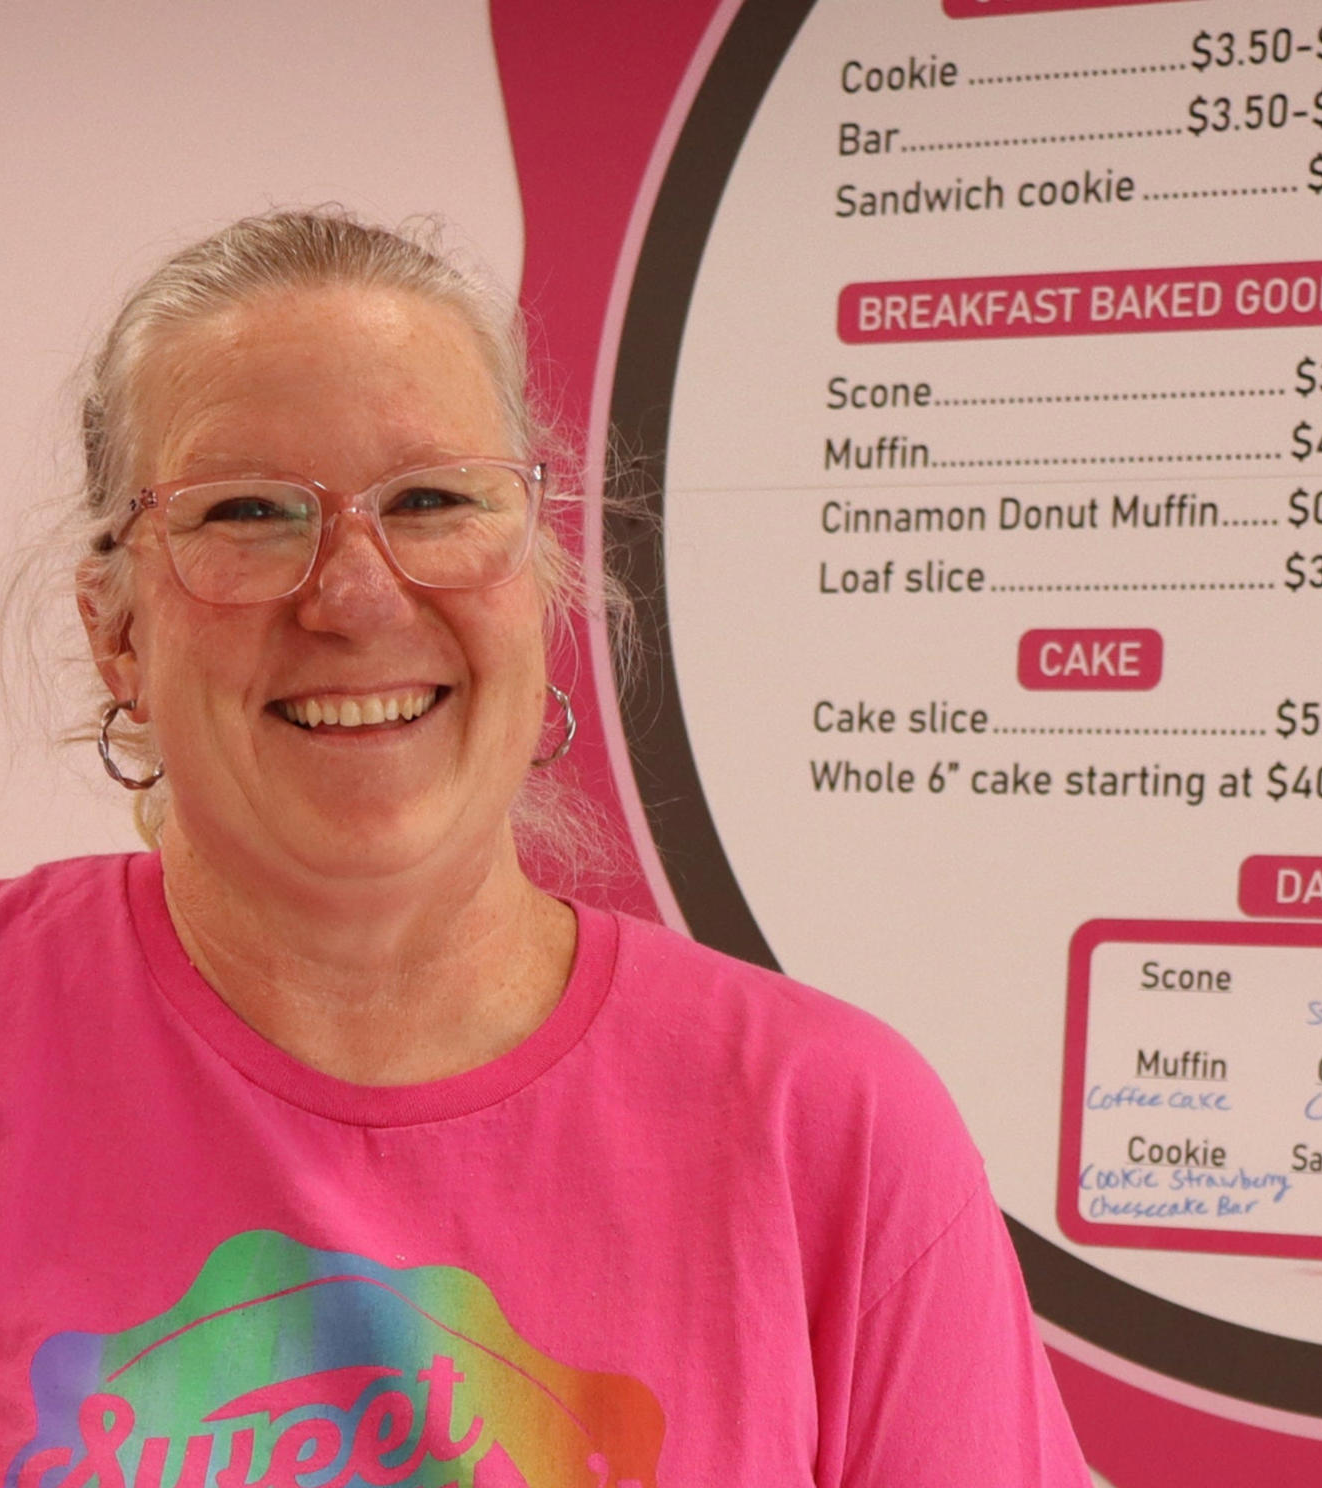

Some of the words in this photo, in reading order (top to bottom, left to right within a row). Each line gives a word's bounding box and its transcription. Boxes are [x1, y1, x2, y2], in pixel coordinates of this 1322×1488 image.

[840, 54, 959, 94] Cookie
[838, 123, 899, 156] Bar
[834, 176, 1004, 219] Sandwich
[1017, 168, 1135, 206] cookie
[857, 286, 1080, 332] BREAKFAST
[1089, 281, 1223, 322] BAKED
[826, 377, 932, 410] Scone
[824, 436, 929, 471] Muffin
[821, 500, 986, 534] Cinnamon
[998, 497, 1099, 530] Donut
[1111, 494, 1219, 528] Muffin
[819, 559, 895, 594] Loaf
[905, 560, 986, 593] slice
[1038, 641, 1141, 677] CAKE
[813, 701, 897, 734] Cake
[908, 701, 989, 735] slice
[810, 760, 915, 794] Whole
[971, 763, 1052, 796] cake
[1064, 764, 1204, 805] starting
[1218, 766, 1252, 798] at
[1140, 962, 1232, 993] Scone
[1135, 1051, 1228, 1081] Muffin
[1128, 1136, 1226, 1167] Cookie
[1080, 1164, 1159, 1190] Cookie
[1169, 1168, 1292, 1202] Strawberry
[1090, 1197, 1208, 1218] Cheesecake
[1217, 1196, 1259, 1217] Bar
